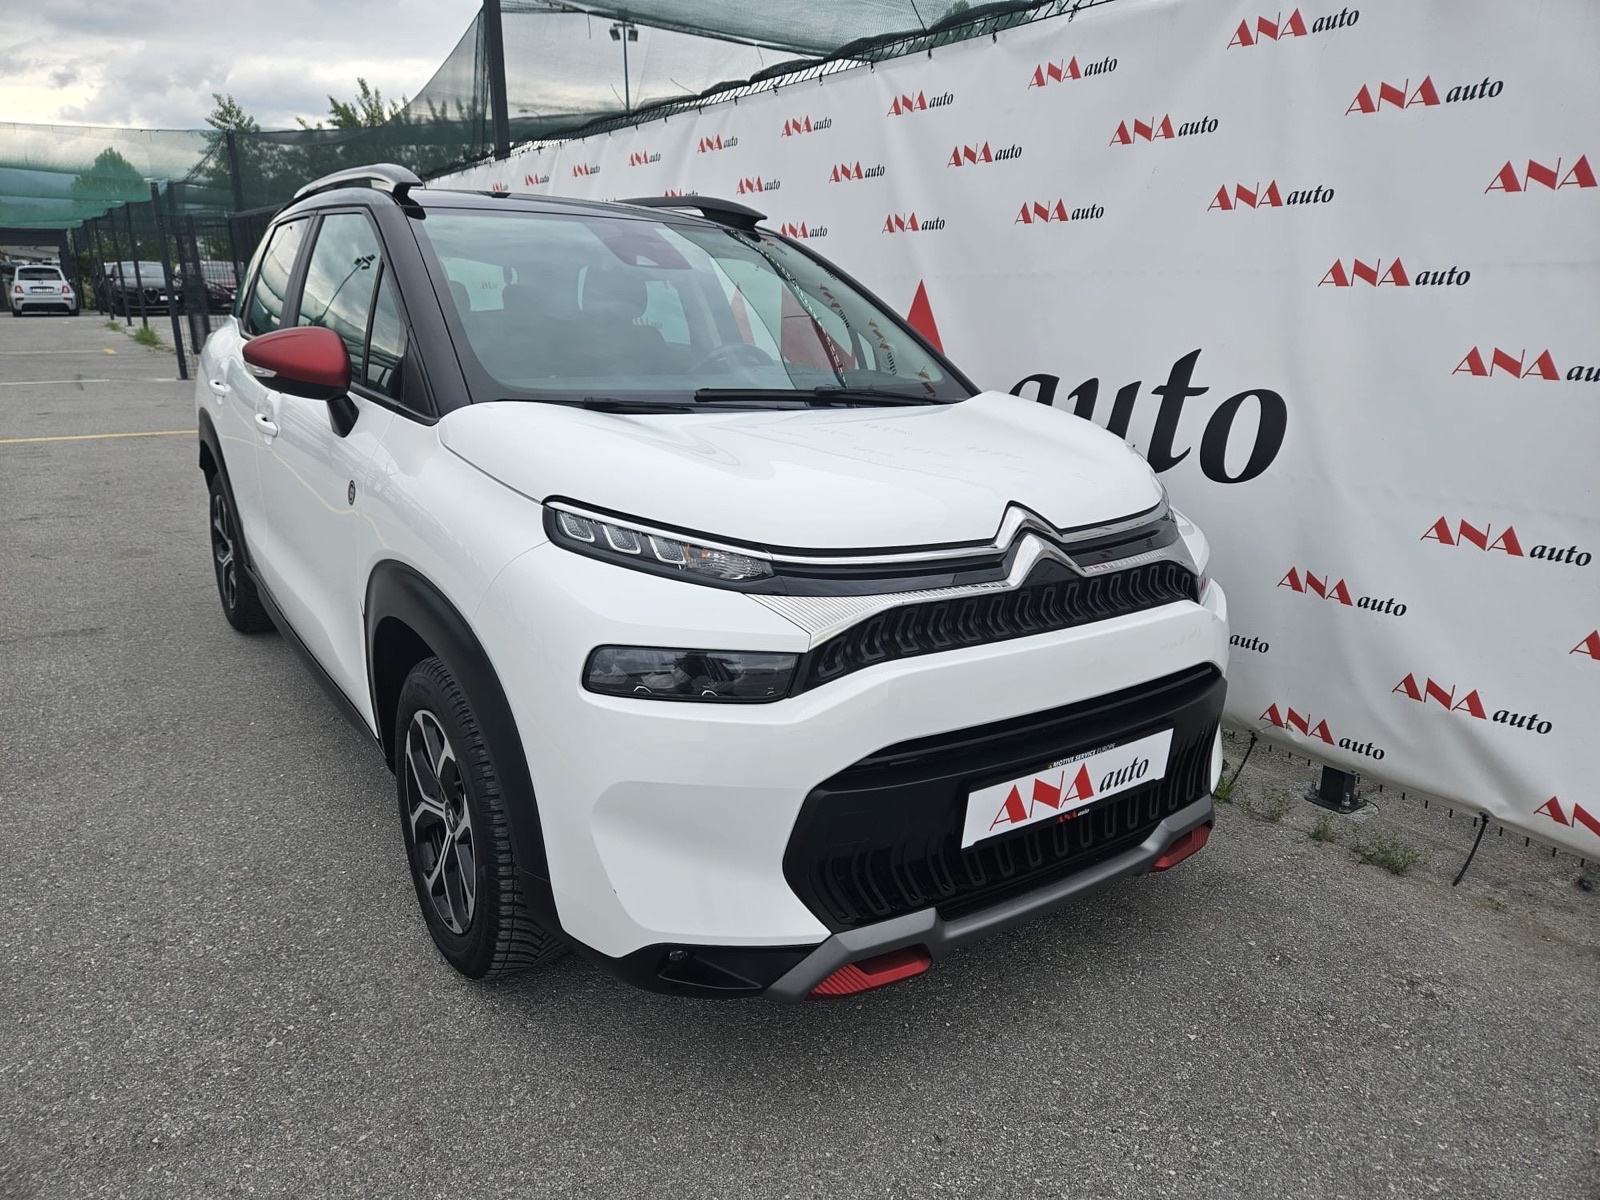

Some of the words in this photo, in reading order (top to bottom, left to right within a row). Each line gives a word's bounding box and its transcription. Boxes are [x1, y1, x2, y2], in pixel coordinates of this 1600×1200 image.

[1226, 6, 1308, 50] ANA
[1312, 8, 1359, 33] auto
[1027, 55, 1082, 90] ANA
[1085, 56, 1117, 77] auto
[887, 91, 928, 118] ANA
[929, 92, 953, 108] auto
[1345, 75, 1441, 117] ANA
[1446, 77, 1503, 103] auto
[781, 115, 813, 138] ANA
[814, 117, 831, 131] auto
[1109, 113, 1176, 147] ANA
[1179, 116, 1218, 136] auto
[697, 134, 722, 153] ANA
[723, 135, 738, 149] auto
[947, 141, 993, 168] ANA
[995, 144, 1022, 161] auto
[572, 163, 589, 177] ANA
[588, 165, 600, 175] auto
[629, 151, 648, 166] ANA
[647, 152, 660, 164] auto
[829, 161, 863, 183] ANA
[865, 165, 885, 178] auto
[525, 174, 539, 185] ANA
[736, 175, 764, 195] ANA
[765, 180, 780, 191] auto
[1484, 154, 1598, 194] ANA
[1207, 179, 1284, 212] ANA
[1287, 185, 1334, 205] auto
[882, 212, 919, 233] ANA
[921, 216, 946, 231] auto
[1014, 198, 1069, 225] ANA
[1072, 204, 1104, 220] auto
[779, 222, 809, 238] ANA
[810, 226, 827, 237] auto
[1317, 256, 1411, 288] ANA
[1415, 266, 1470, 285] auto
[1452, 346, 1561, 381] ANA
[1420, 515, 1525, 557] ANA
[1530, 545, 1591, 566] auto
[1276, 566, 1354, 607] ANA
[1357, 597, 1406, 616] auto
[1230, 634, 1269, 653] auto
[1391, 672, 1488, 720] ANA
[1493, 710, 1552, 734] auto
[1258, 703, 1335, 746] ANA
[1338, 739, 1385, 761] auto
[989, 762, 1094, 831] ANA
[1099, 756, 1149, 793] auto
